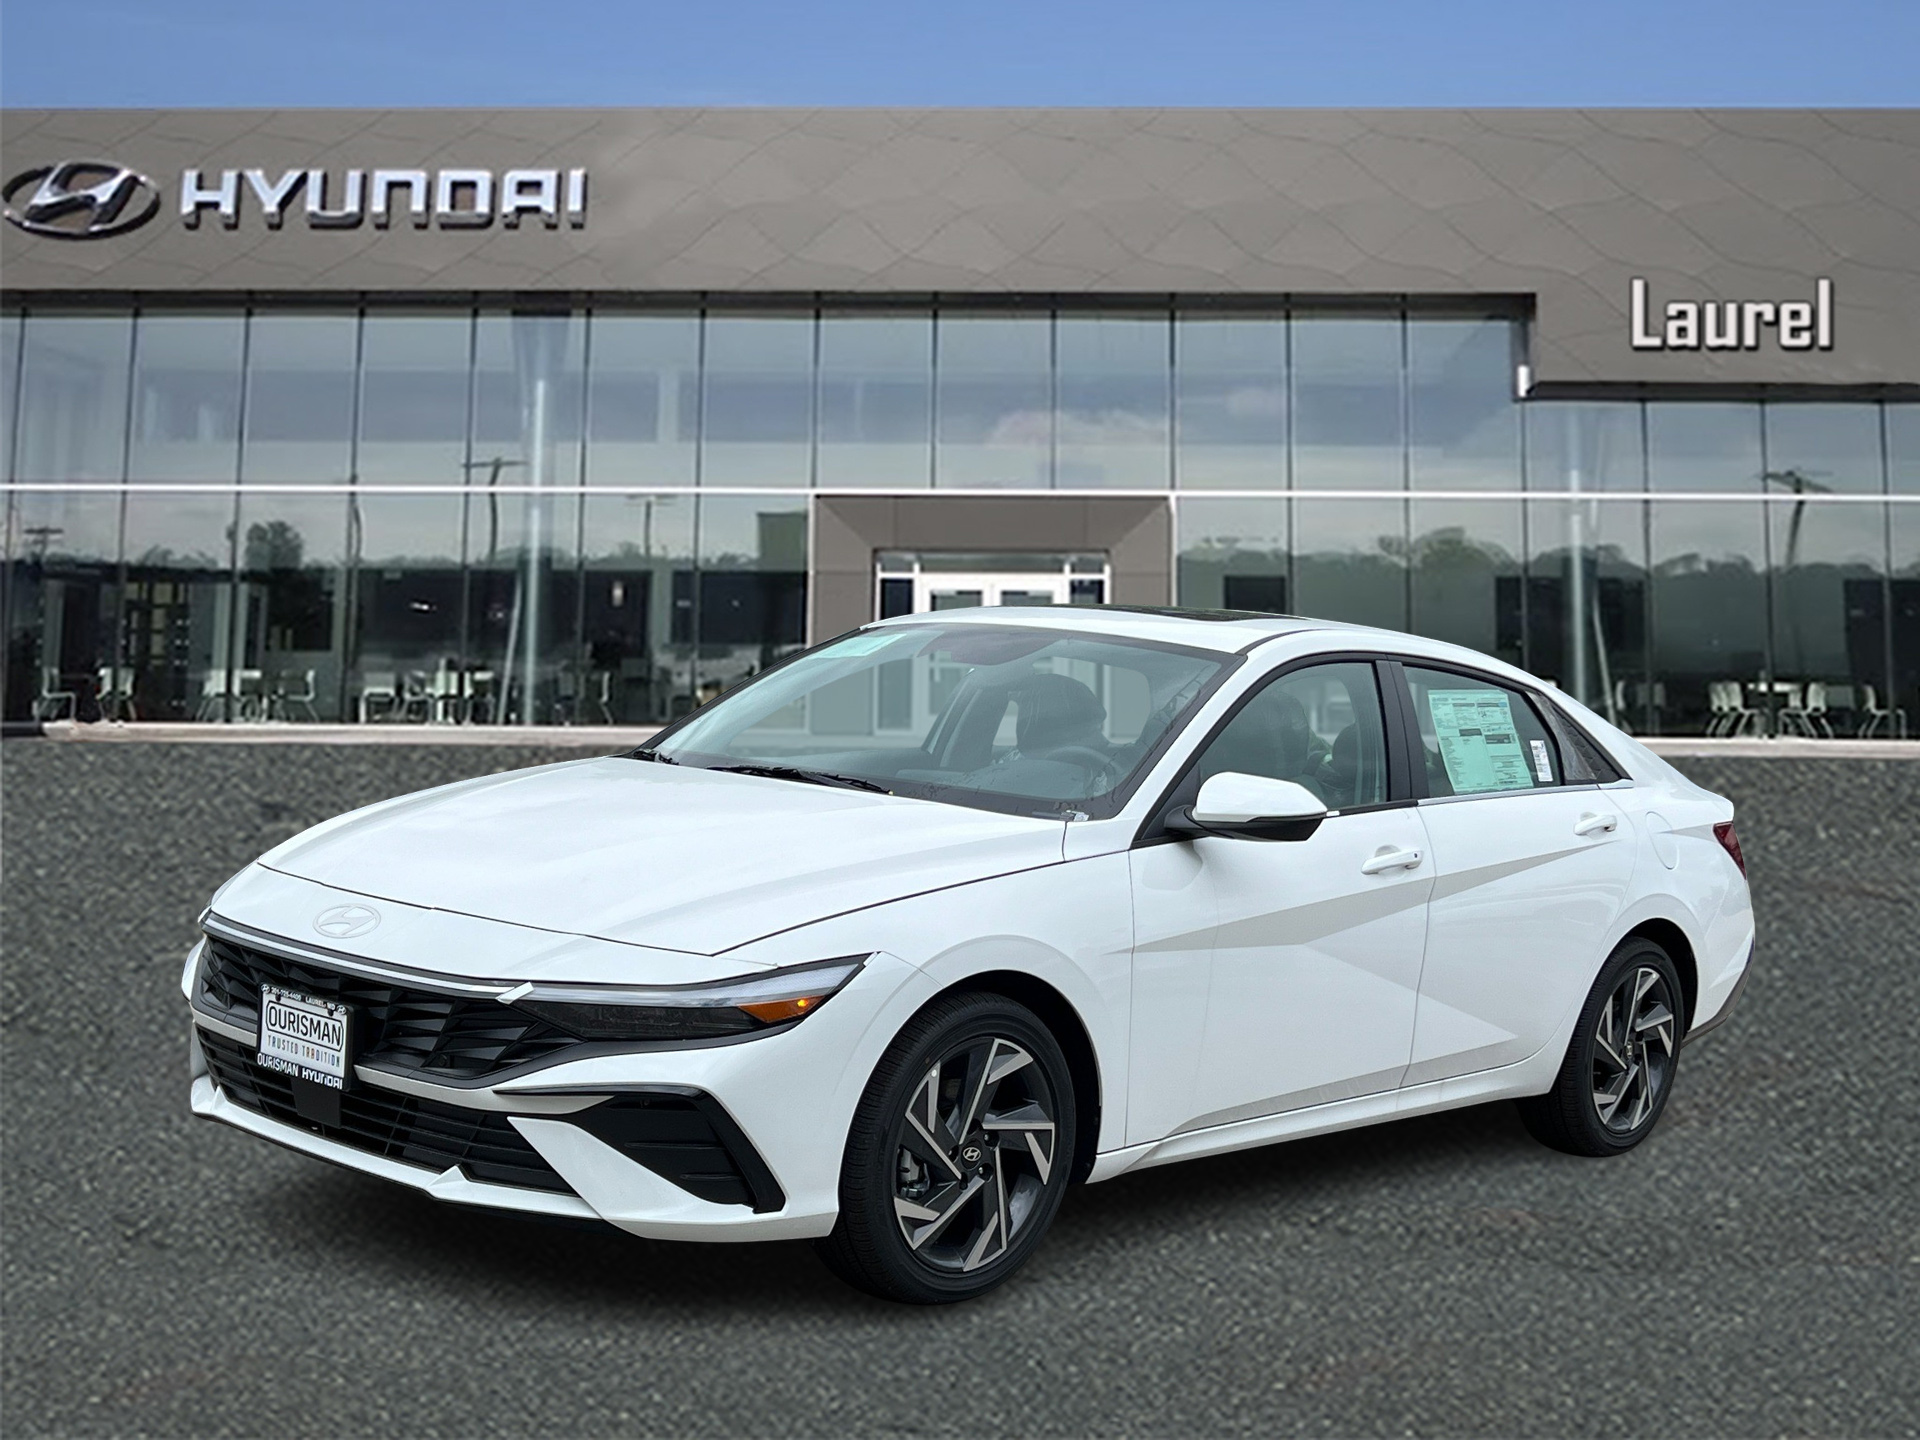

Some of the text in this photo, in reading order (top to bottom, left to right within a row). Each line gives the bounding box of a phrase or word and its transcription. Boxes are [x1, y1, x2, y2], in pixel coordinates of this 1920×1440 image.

[180, 168, 588, 229] HYUNDAI
[1631, 277, 1833, 350] Laurel
[268, 1005, 341, 1047] OURISMAN
[257, 1052, 343, 1090] OURISMAN HYUNDAI
[268, 1034, 340, 1068] TRUSTED TRADITION
